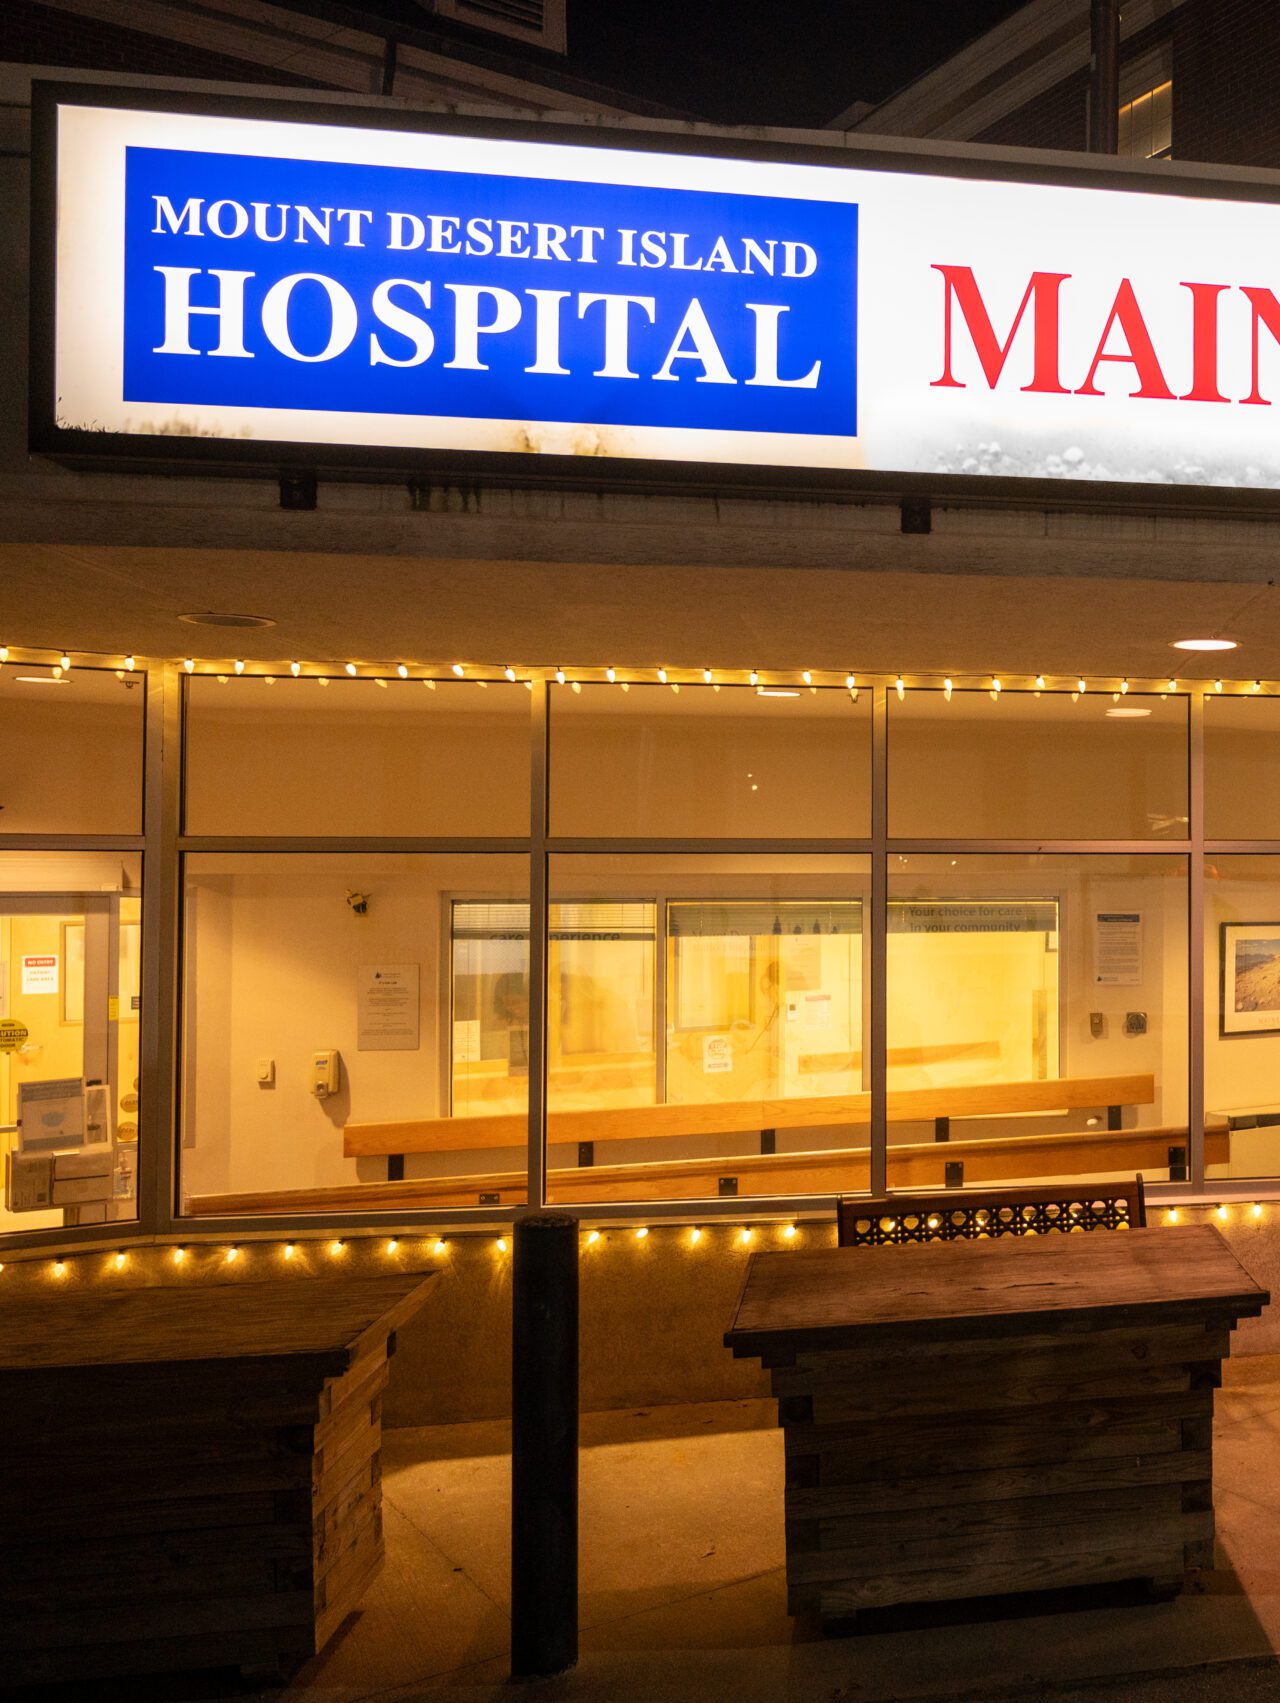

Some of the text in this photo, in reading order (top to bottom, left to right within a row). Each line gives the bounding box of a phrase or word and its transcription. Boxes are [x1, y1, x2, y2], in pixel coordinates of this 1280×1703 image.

[151, 195, 818, 278] MOUNT DESERT ISLAND
[152, 265, 822, 389] HOSPITAL
[909, 907, 1022, 917] Your choice for care
[925, 923, 952, 932] your
[954, 922, 1021, 932] community
[548, 932, 621, 941] perience
